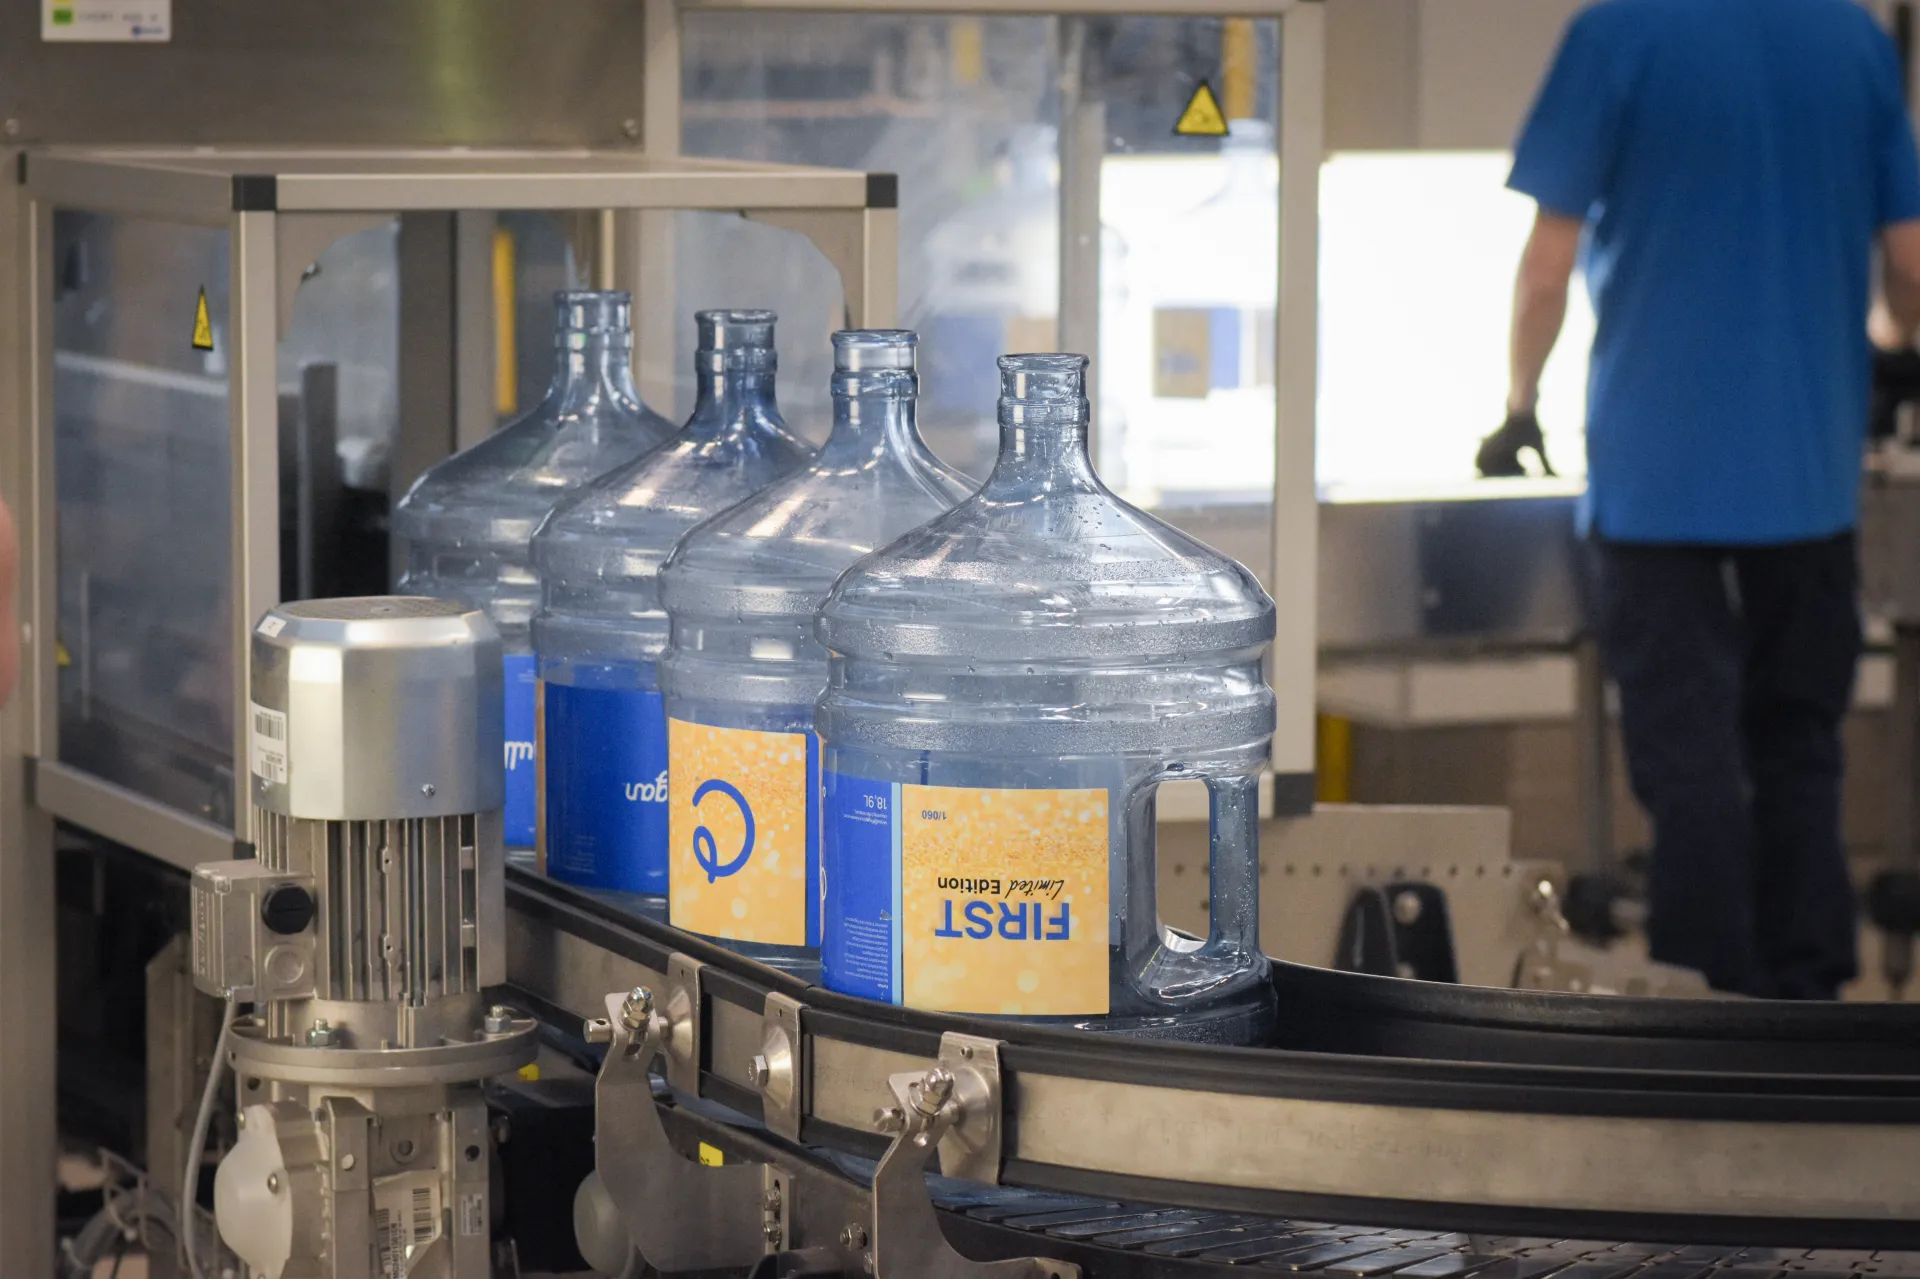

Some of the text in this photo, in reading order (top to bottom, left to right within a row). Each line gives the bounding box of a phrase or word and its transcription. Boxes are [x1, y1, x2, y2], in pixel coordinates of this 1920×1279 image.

[864, 794, 888, 809] 18,9L
[937, 877, 1065, 900] Limited Edition
[935, 900, 1070, 940] FIRST
